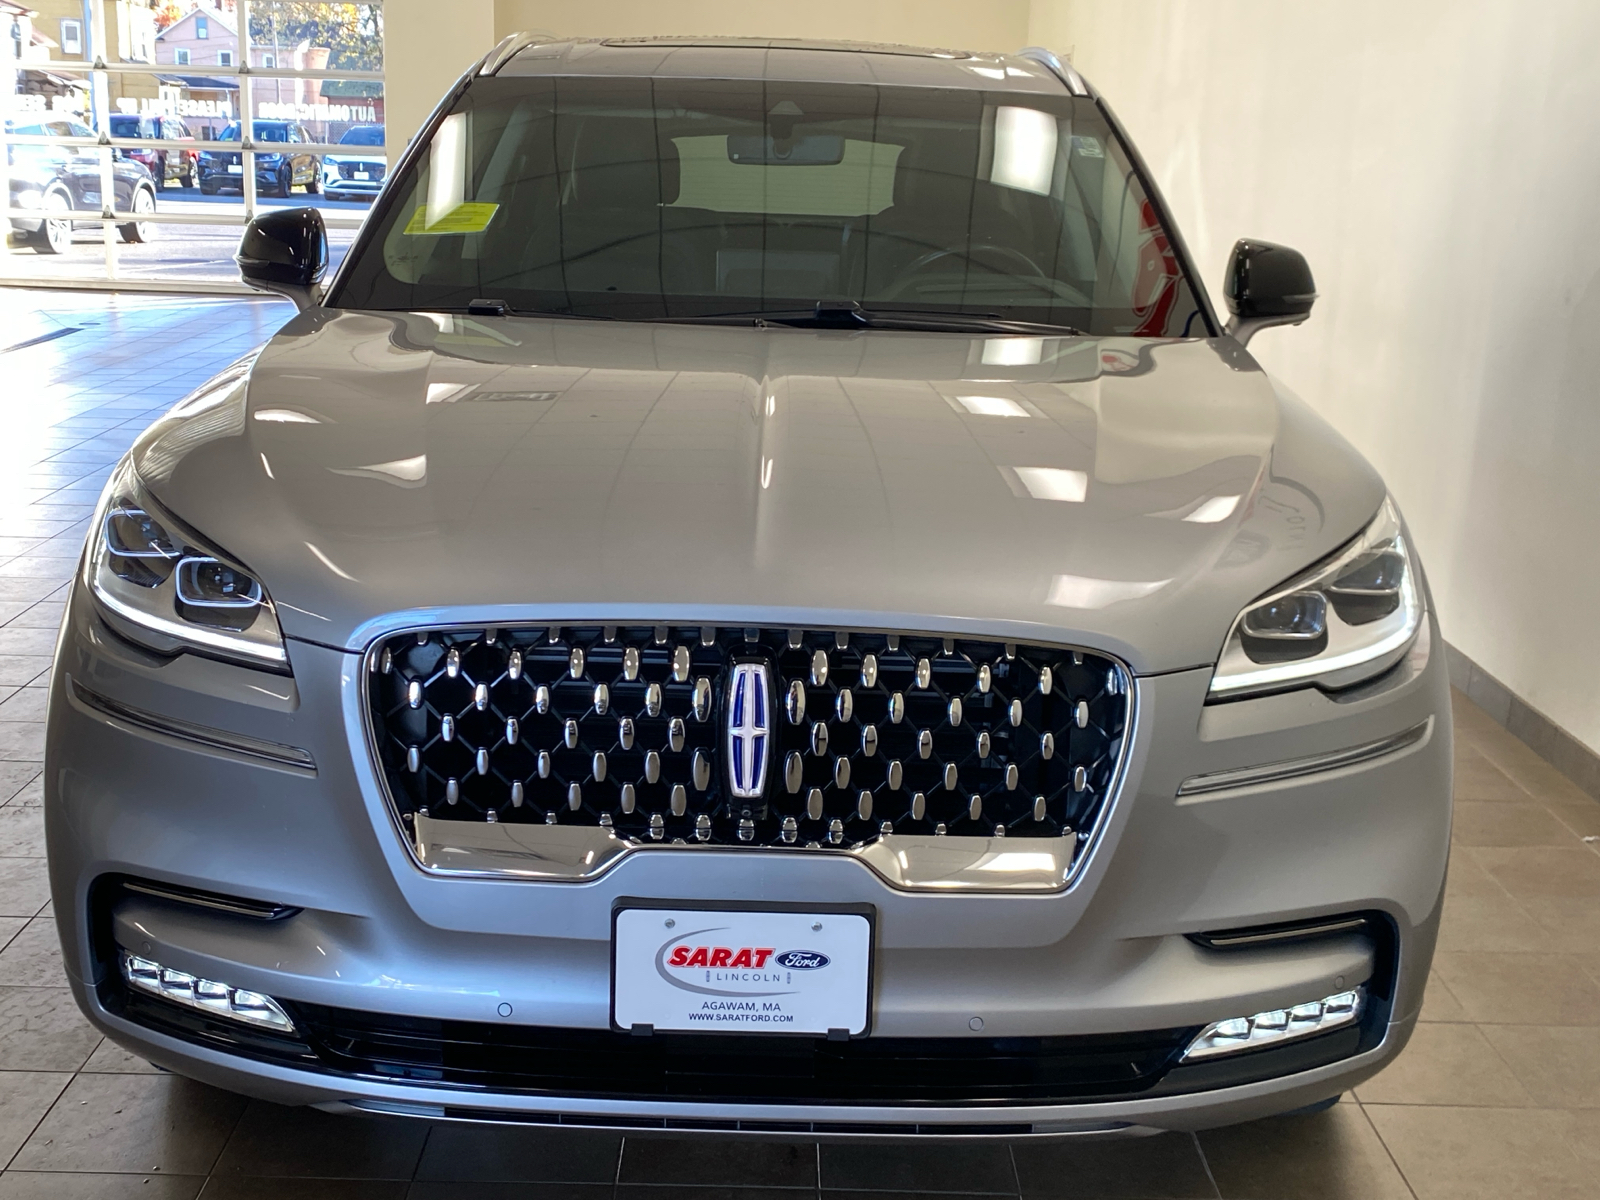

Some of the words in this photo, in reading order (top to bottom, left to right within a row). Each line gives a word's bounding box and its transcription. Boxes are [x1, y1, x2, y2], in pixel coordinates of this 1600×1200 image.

[668, 945, 776, 970] SARAT
[785, 952, 821, 968] Ford
[716, 973, 780, 982] LINCOLN
[701, 1001, 759, 1012] AGAWAM,
[763, 1002, 781, 1012] MA
[688, 1012, 794, 1023] WWW.SARATFORD.COM
